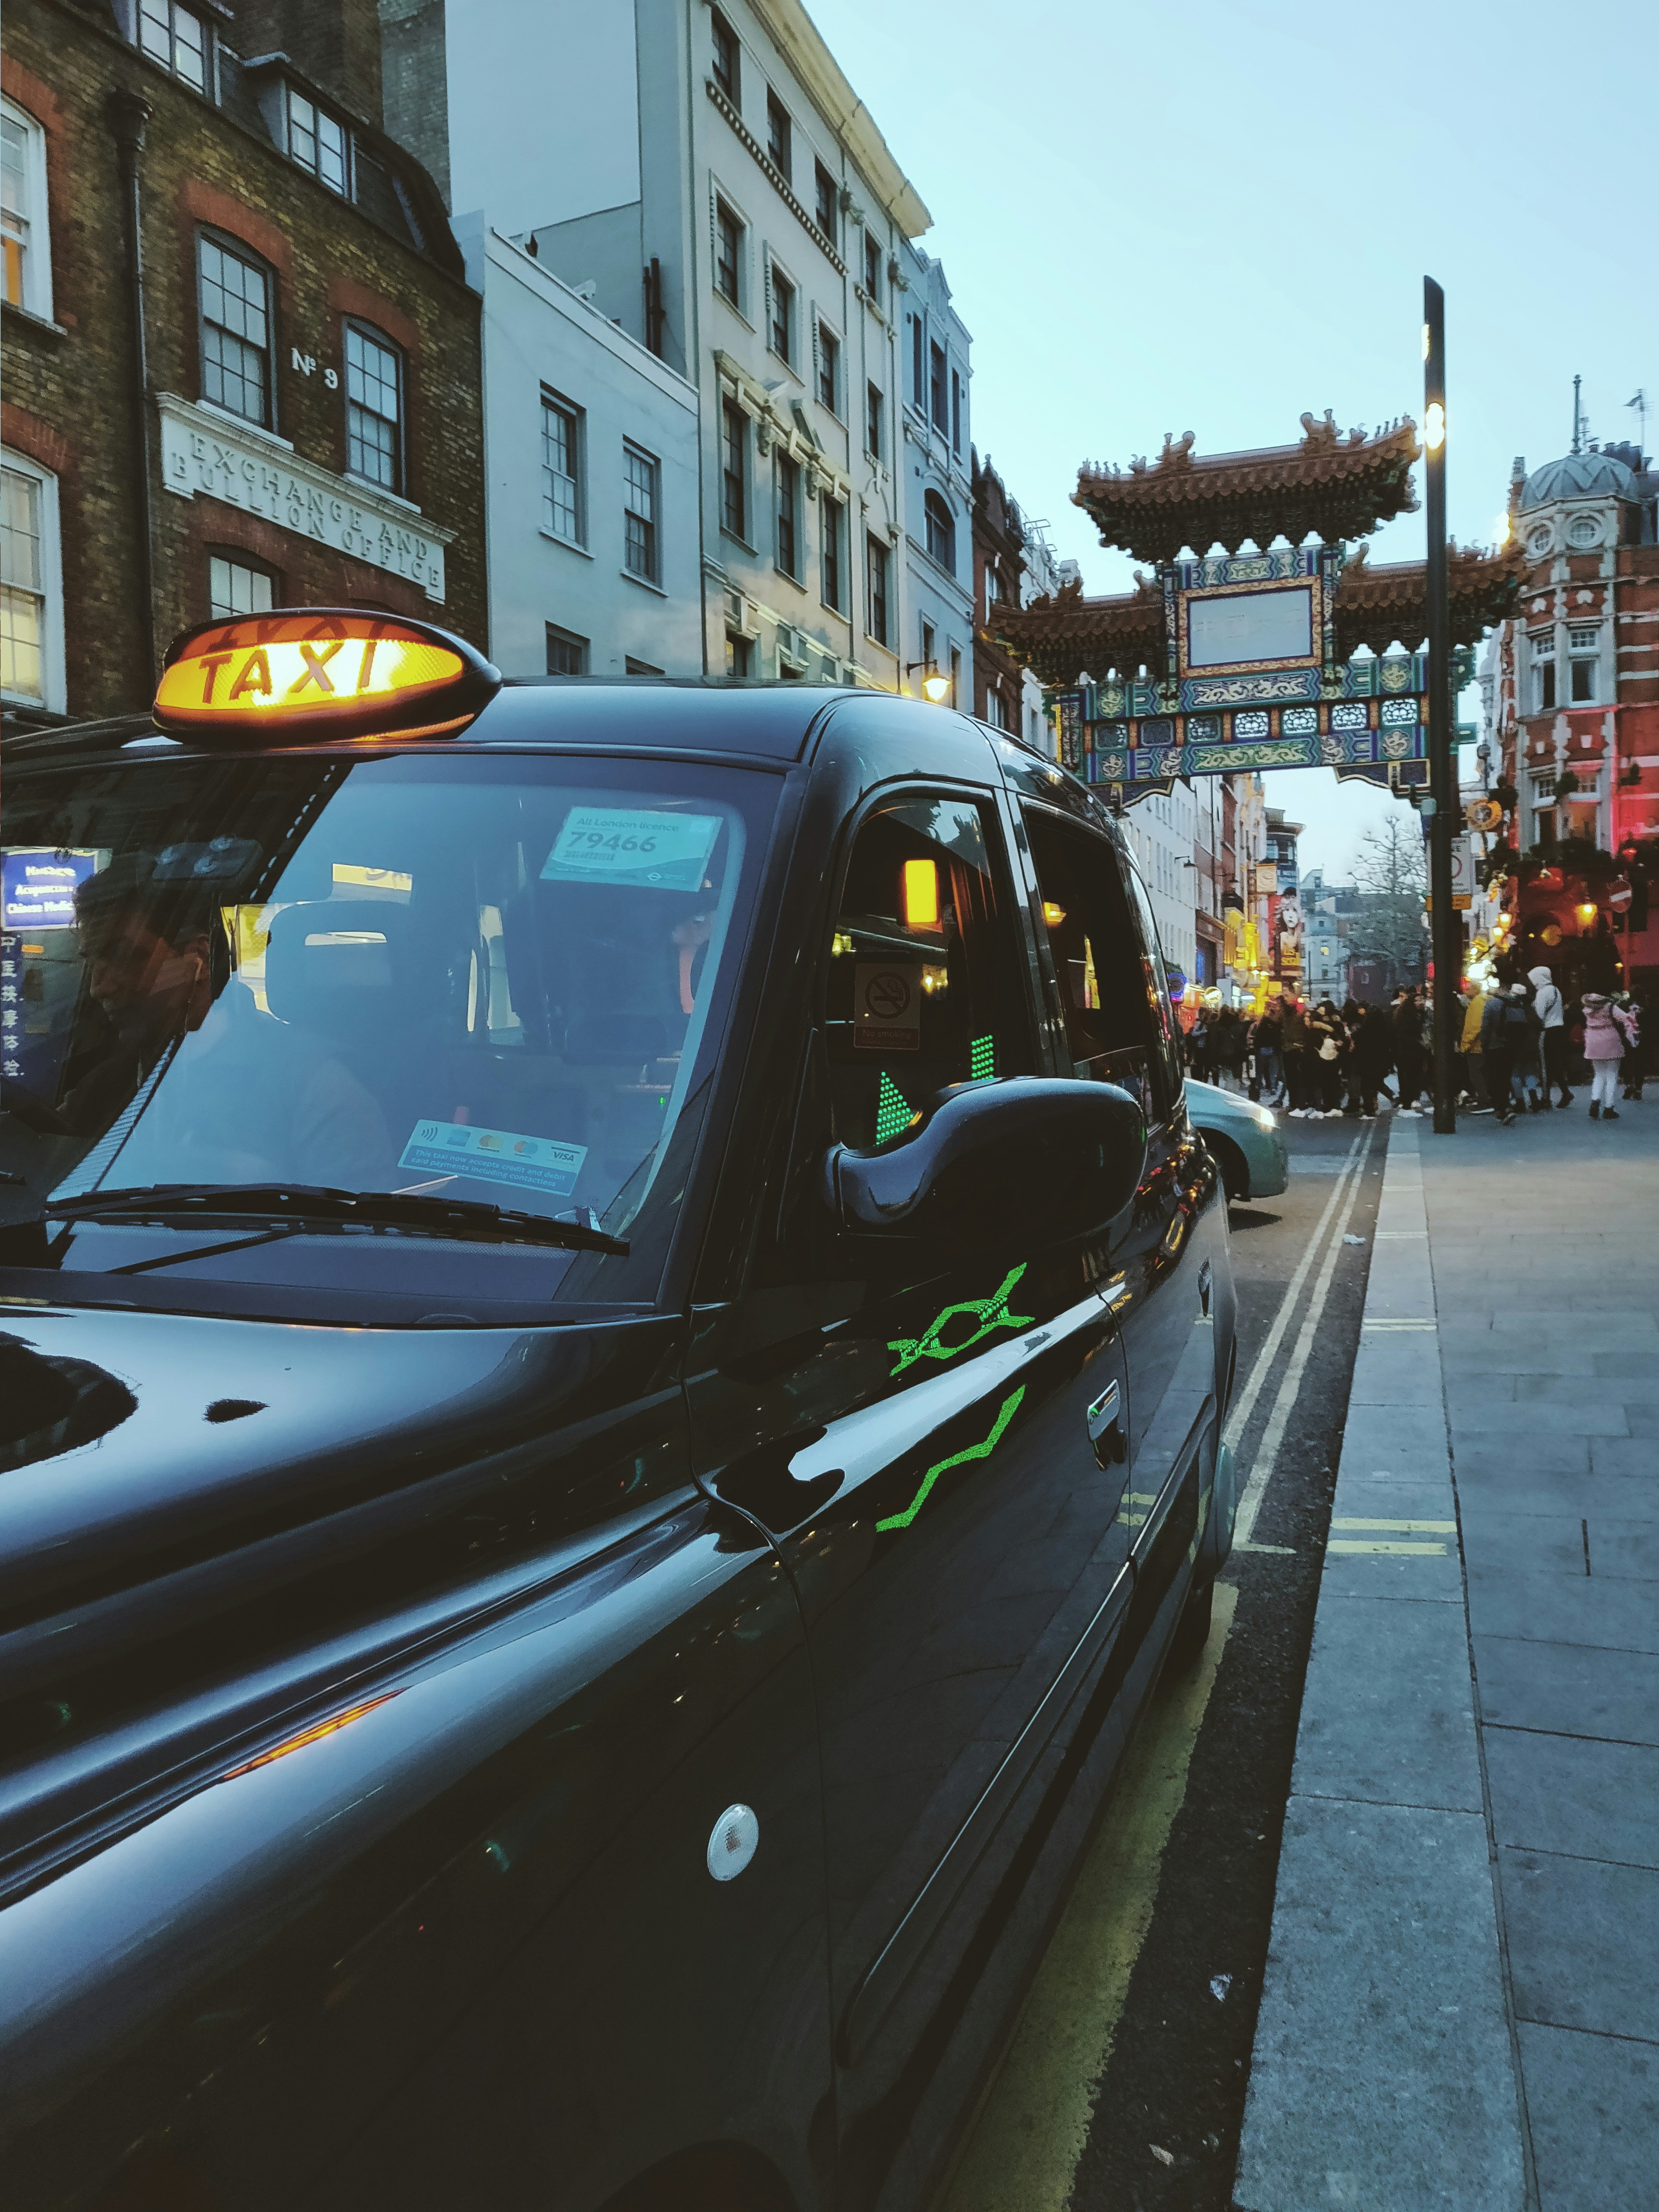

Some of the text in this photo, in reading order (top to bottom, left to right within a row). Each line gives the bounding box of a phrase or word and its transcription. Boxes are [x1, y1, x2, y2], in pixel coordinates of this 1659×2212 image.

[324, 368, 338, 389] 9
[190, 433, 427, 560] EXCHANGE AND
[171, 452, 439, 588] BULLION OFFICE
[199, 642, 378, 704] TAXI
[577, 817, 592, 826] All
[594, 818, 636, 829] London
[639, 821, 679, 832] licence
[566, 831, 658, 853] 79466
[863, 1029, 912, 1040] No smoking
[416, 1149, 431, 1157] This
[469, 1158, 500, 1169] accepts
[502, 1163, 525, 1173] credit
[527, 1168, 542, 1177] and
[544, 1171, 566, 1181] debit
[552, 1151, 575, 1163] VISA
[411, 1156, 556, 1187] card payments including contactless
